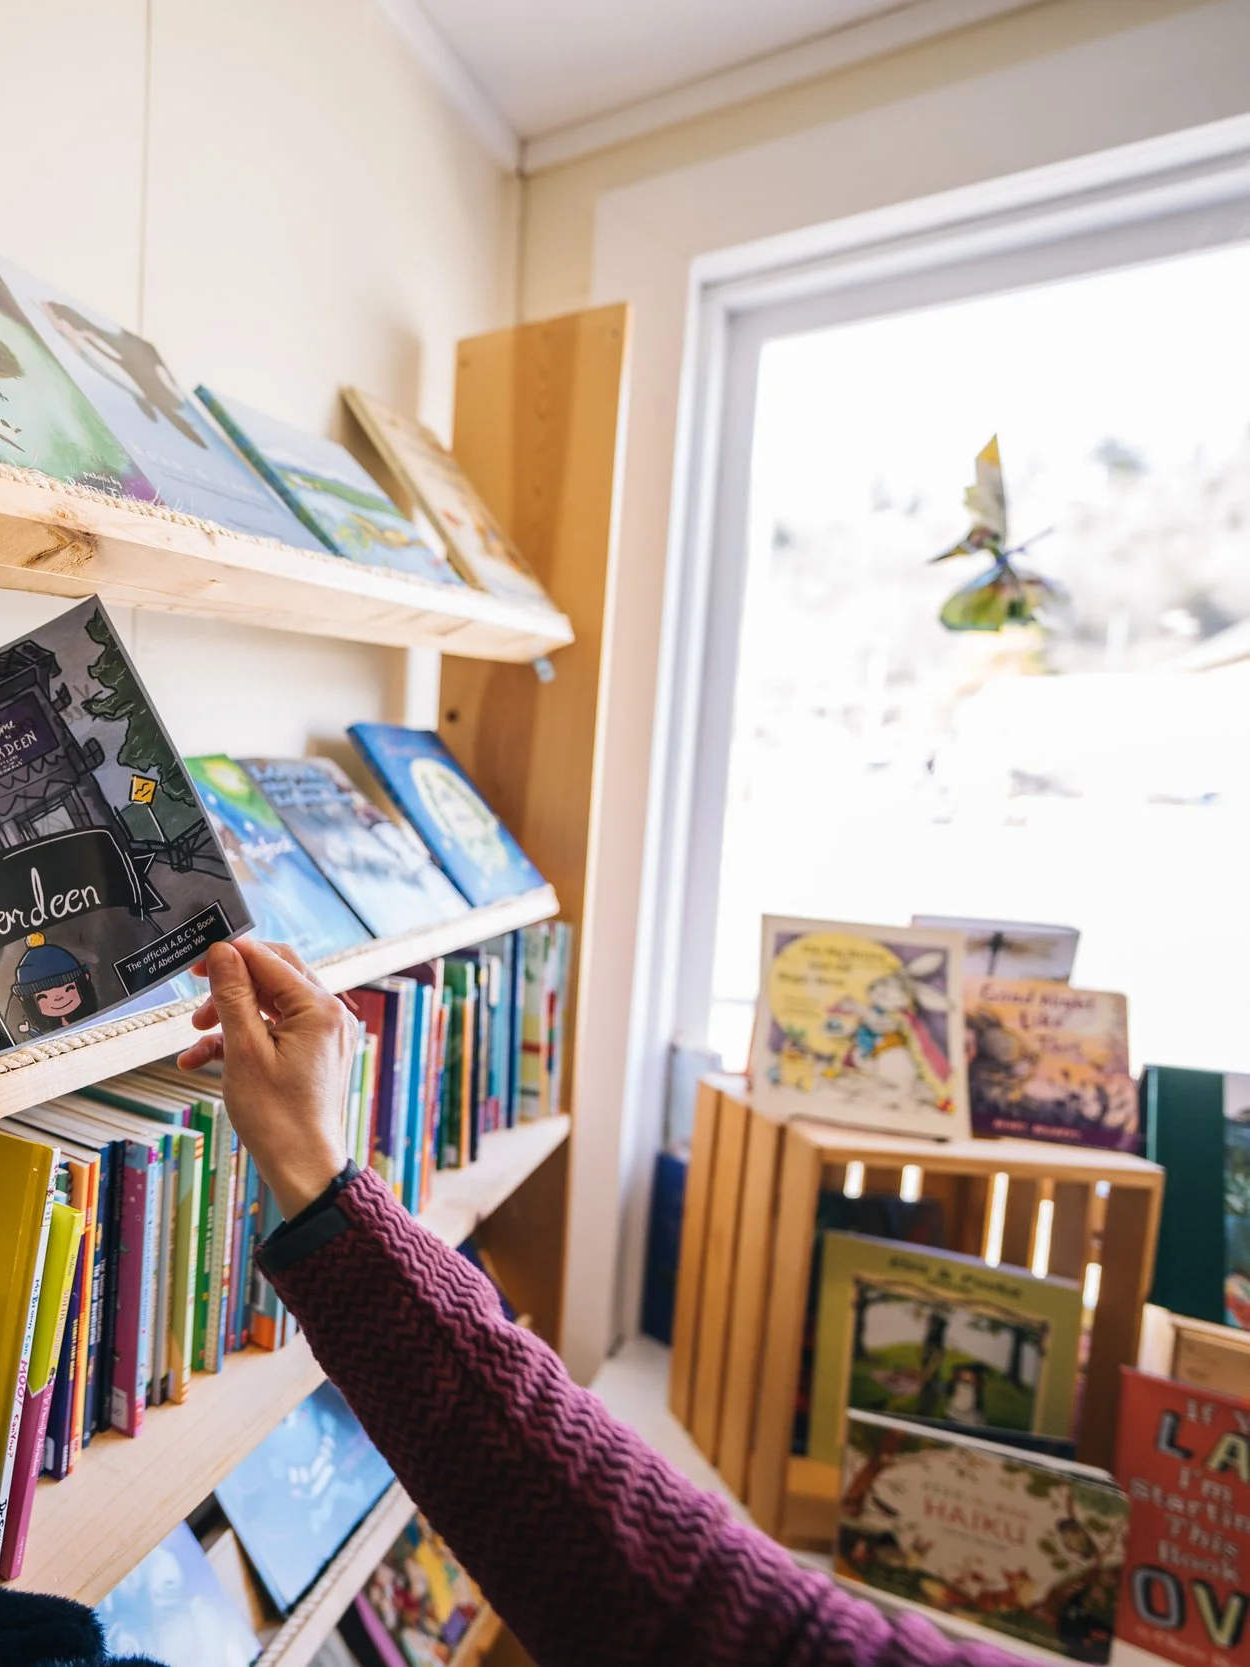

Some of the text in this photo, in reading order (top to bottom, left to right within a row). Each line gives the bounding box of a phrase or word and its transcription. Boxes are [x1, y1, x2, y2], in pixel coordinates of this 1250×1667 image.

[126, 915, 216, 973] The official A,B,C's Book
[148, 934, 206, 974] of Aberdeen WA
[27, 1294, 40, 1330] Brown
[23, 1334, 32, 1355] Can
[16, 1359, 29, 1407] MOO!
[12, 1413, 20, 1433] Can
[38, 1404, 50, 1434] Family
[7, 1432, 17, 1458] You?
[1178, 1465, 1234, 1503] I'm
[922, 1494, 1029, 1550] HAIKU
[1165, 1513, 1240, 1558] This
[1157, 1539, 1240, 1584] Book
